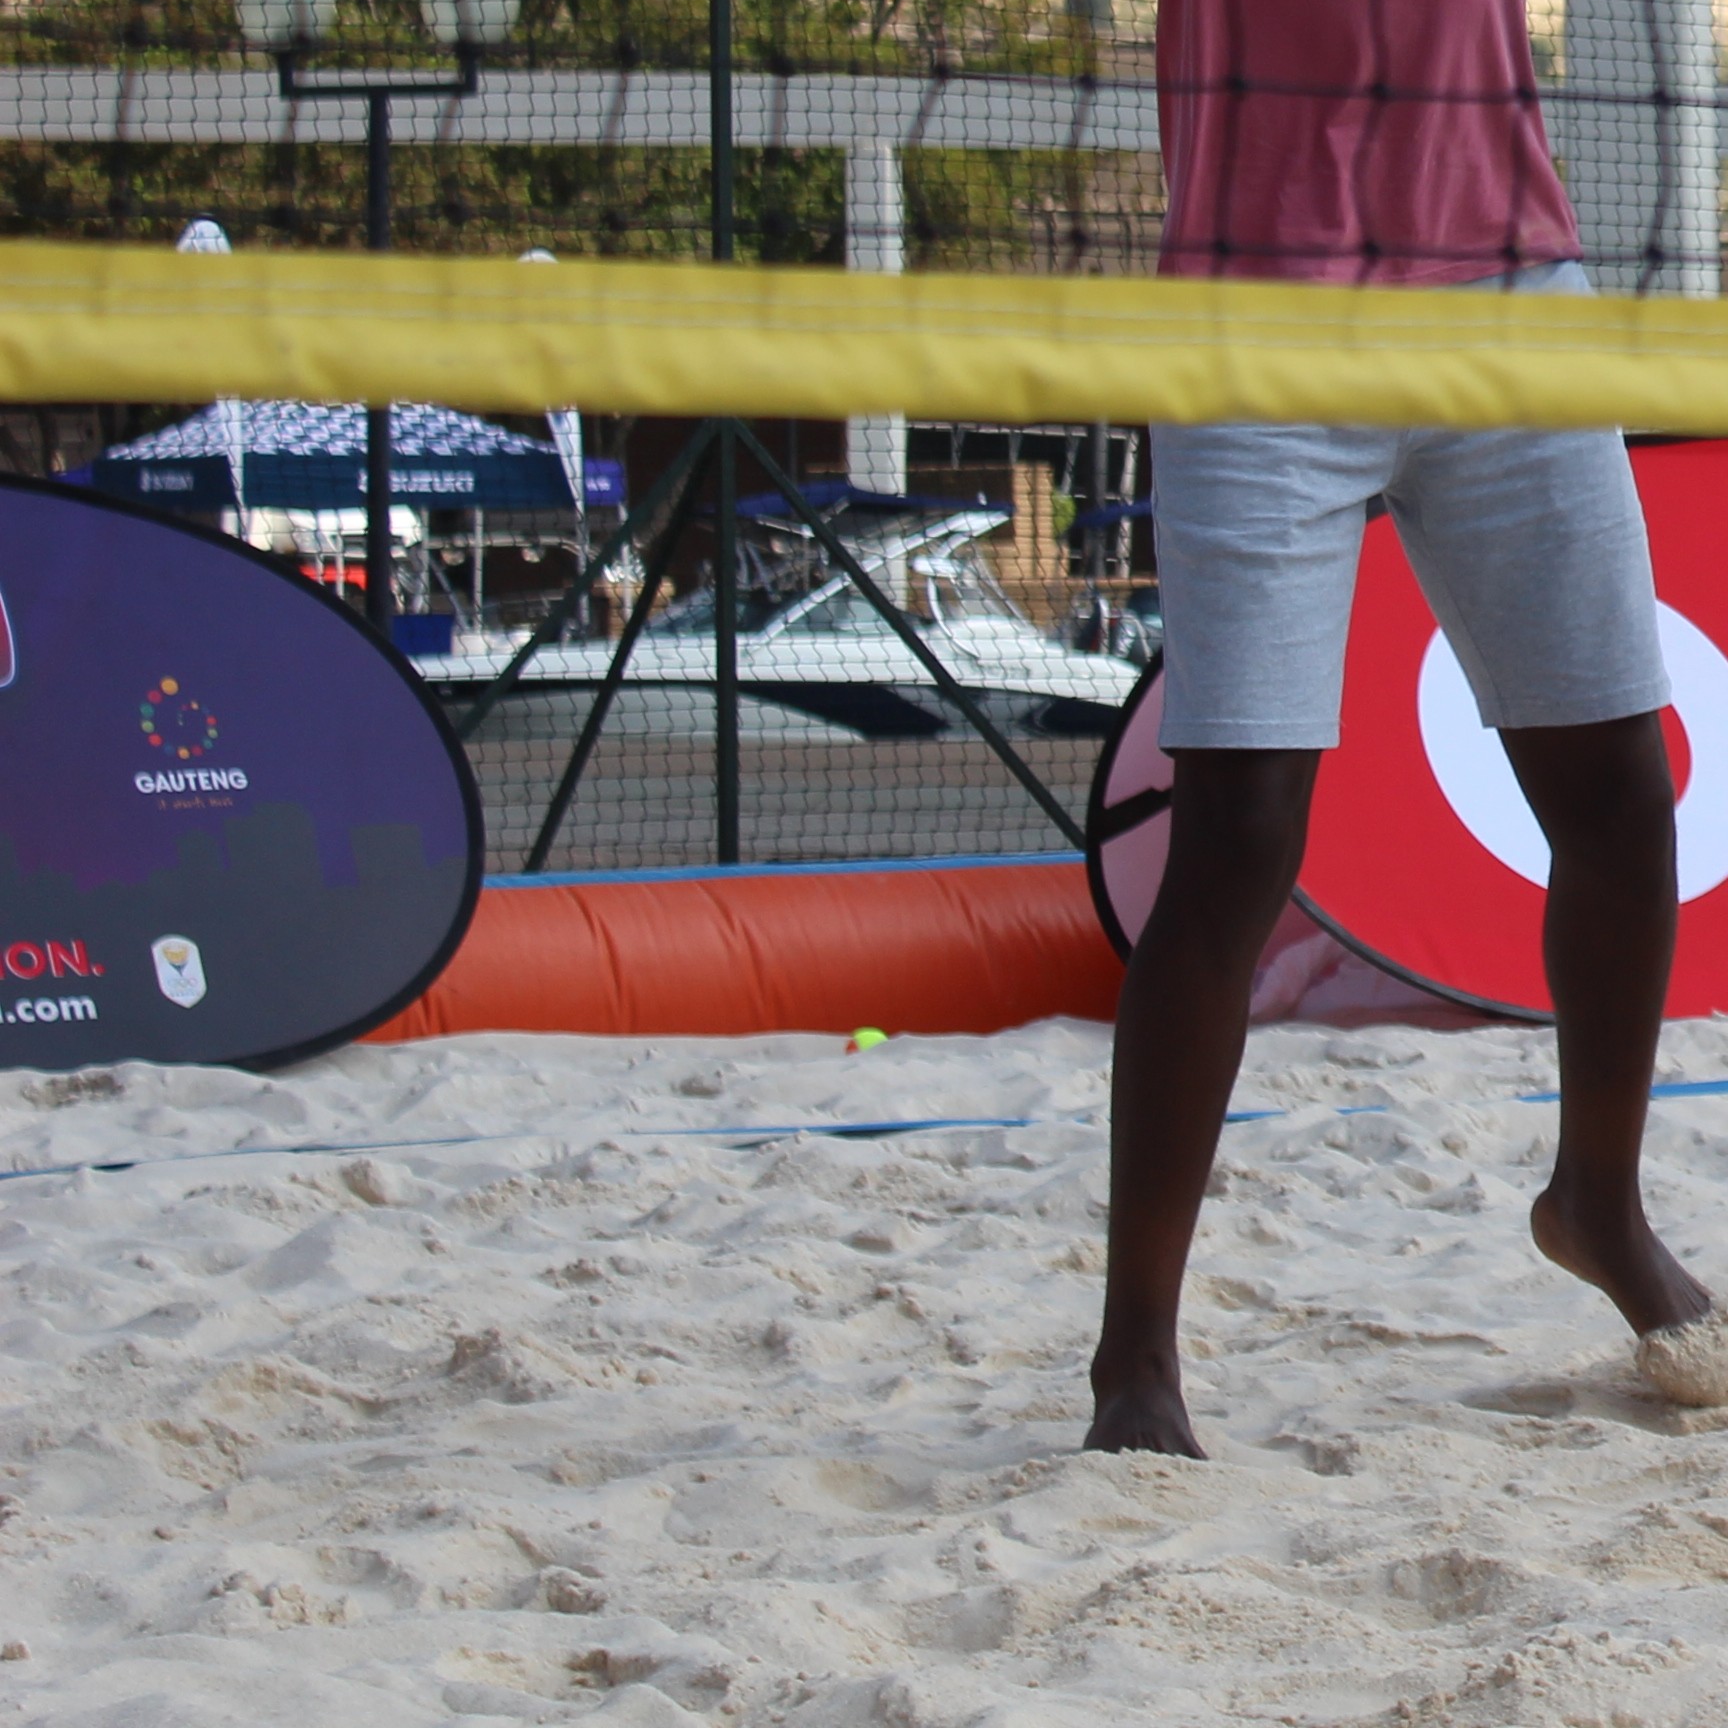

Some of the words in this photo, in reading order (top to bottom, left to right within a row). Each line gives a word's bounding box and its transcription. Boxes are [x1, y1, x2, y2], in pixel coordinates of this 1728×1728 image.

[134, 767, 248, 794] GAUTENG
[0, 939, 107, 980] ON.
[0, 994, 98, 1024] .com
